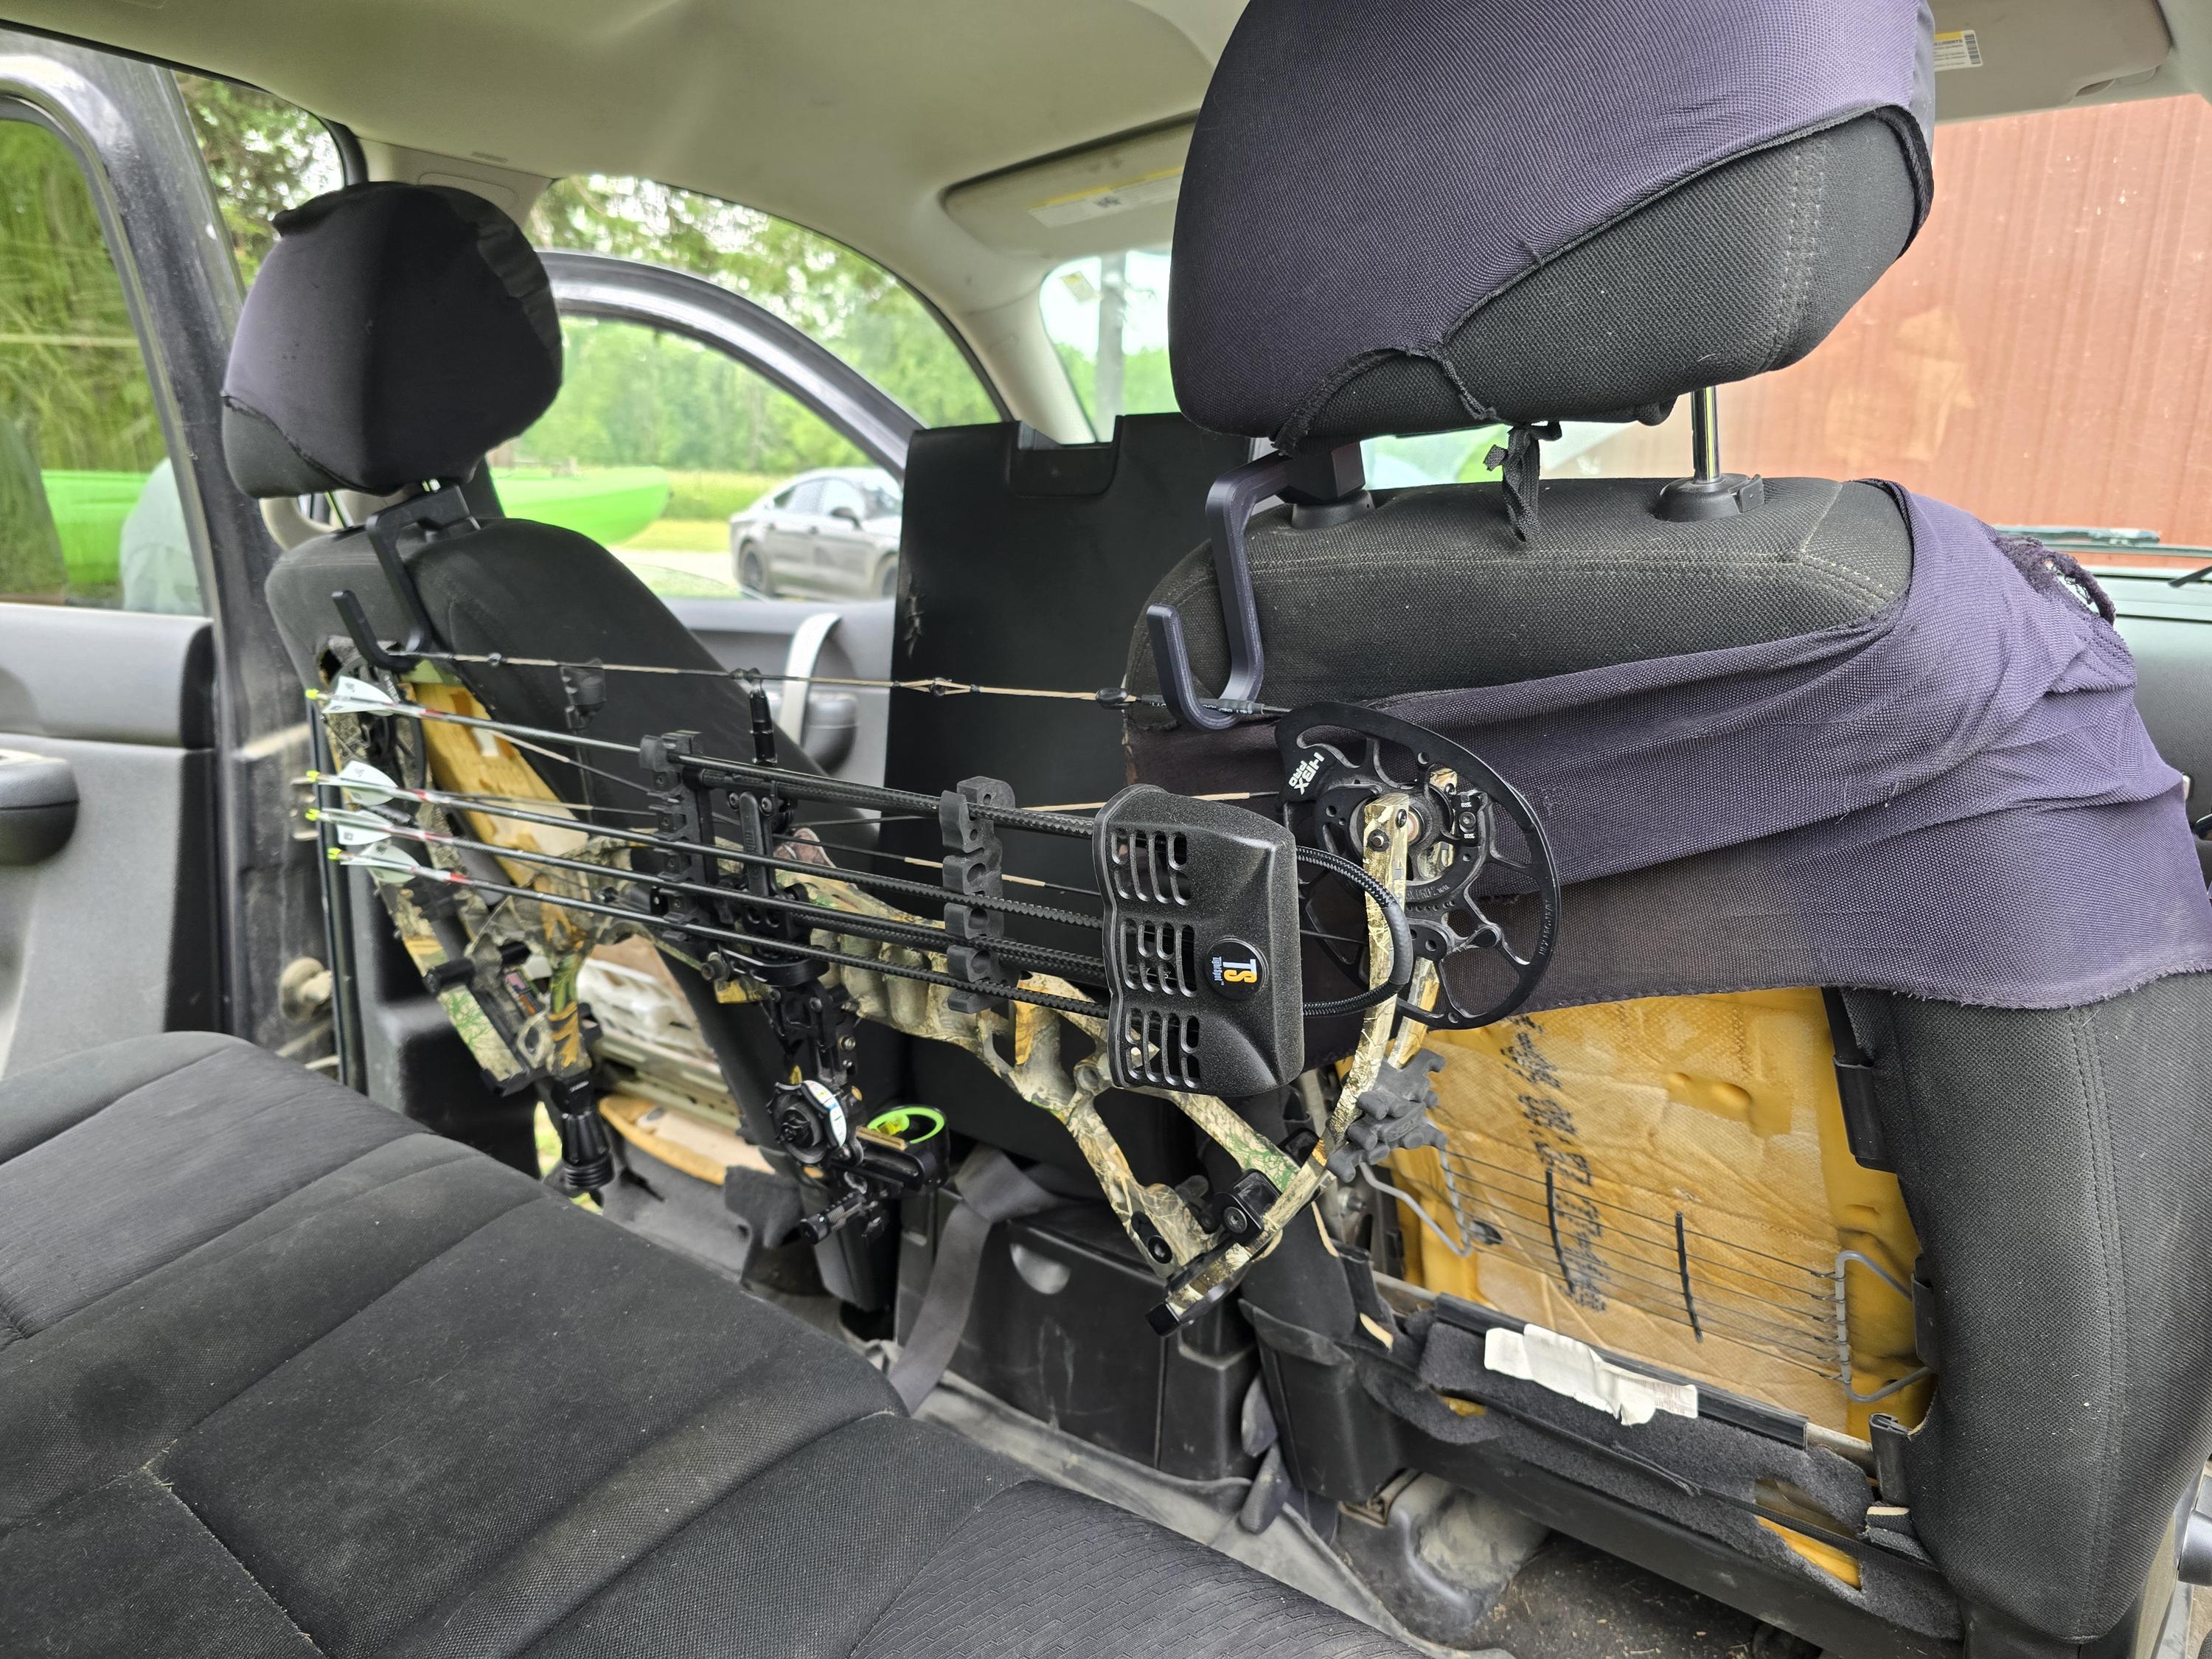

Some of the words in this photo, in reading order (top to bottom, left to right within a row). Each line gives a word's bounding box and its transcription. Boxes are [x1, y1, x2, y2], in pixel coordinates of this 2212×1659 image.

[1288, 759, 1307, 787] PRO
[1295, 751, 1325, 795] HBX
[1222, 959, 1257, 984] TS
